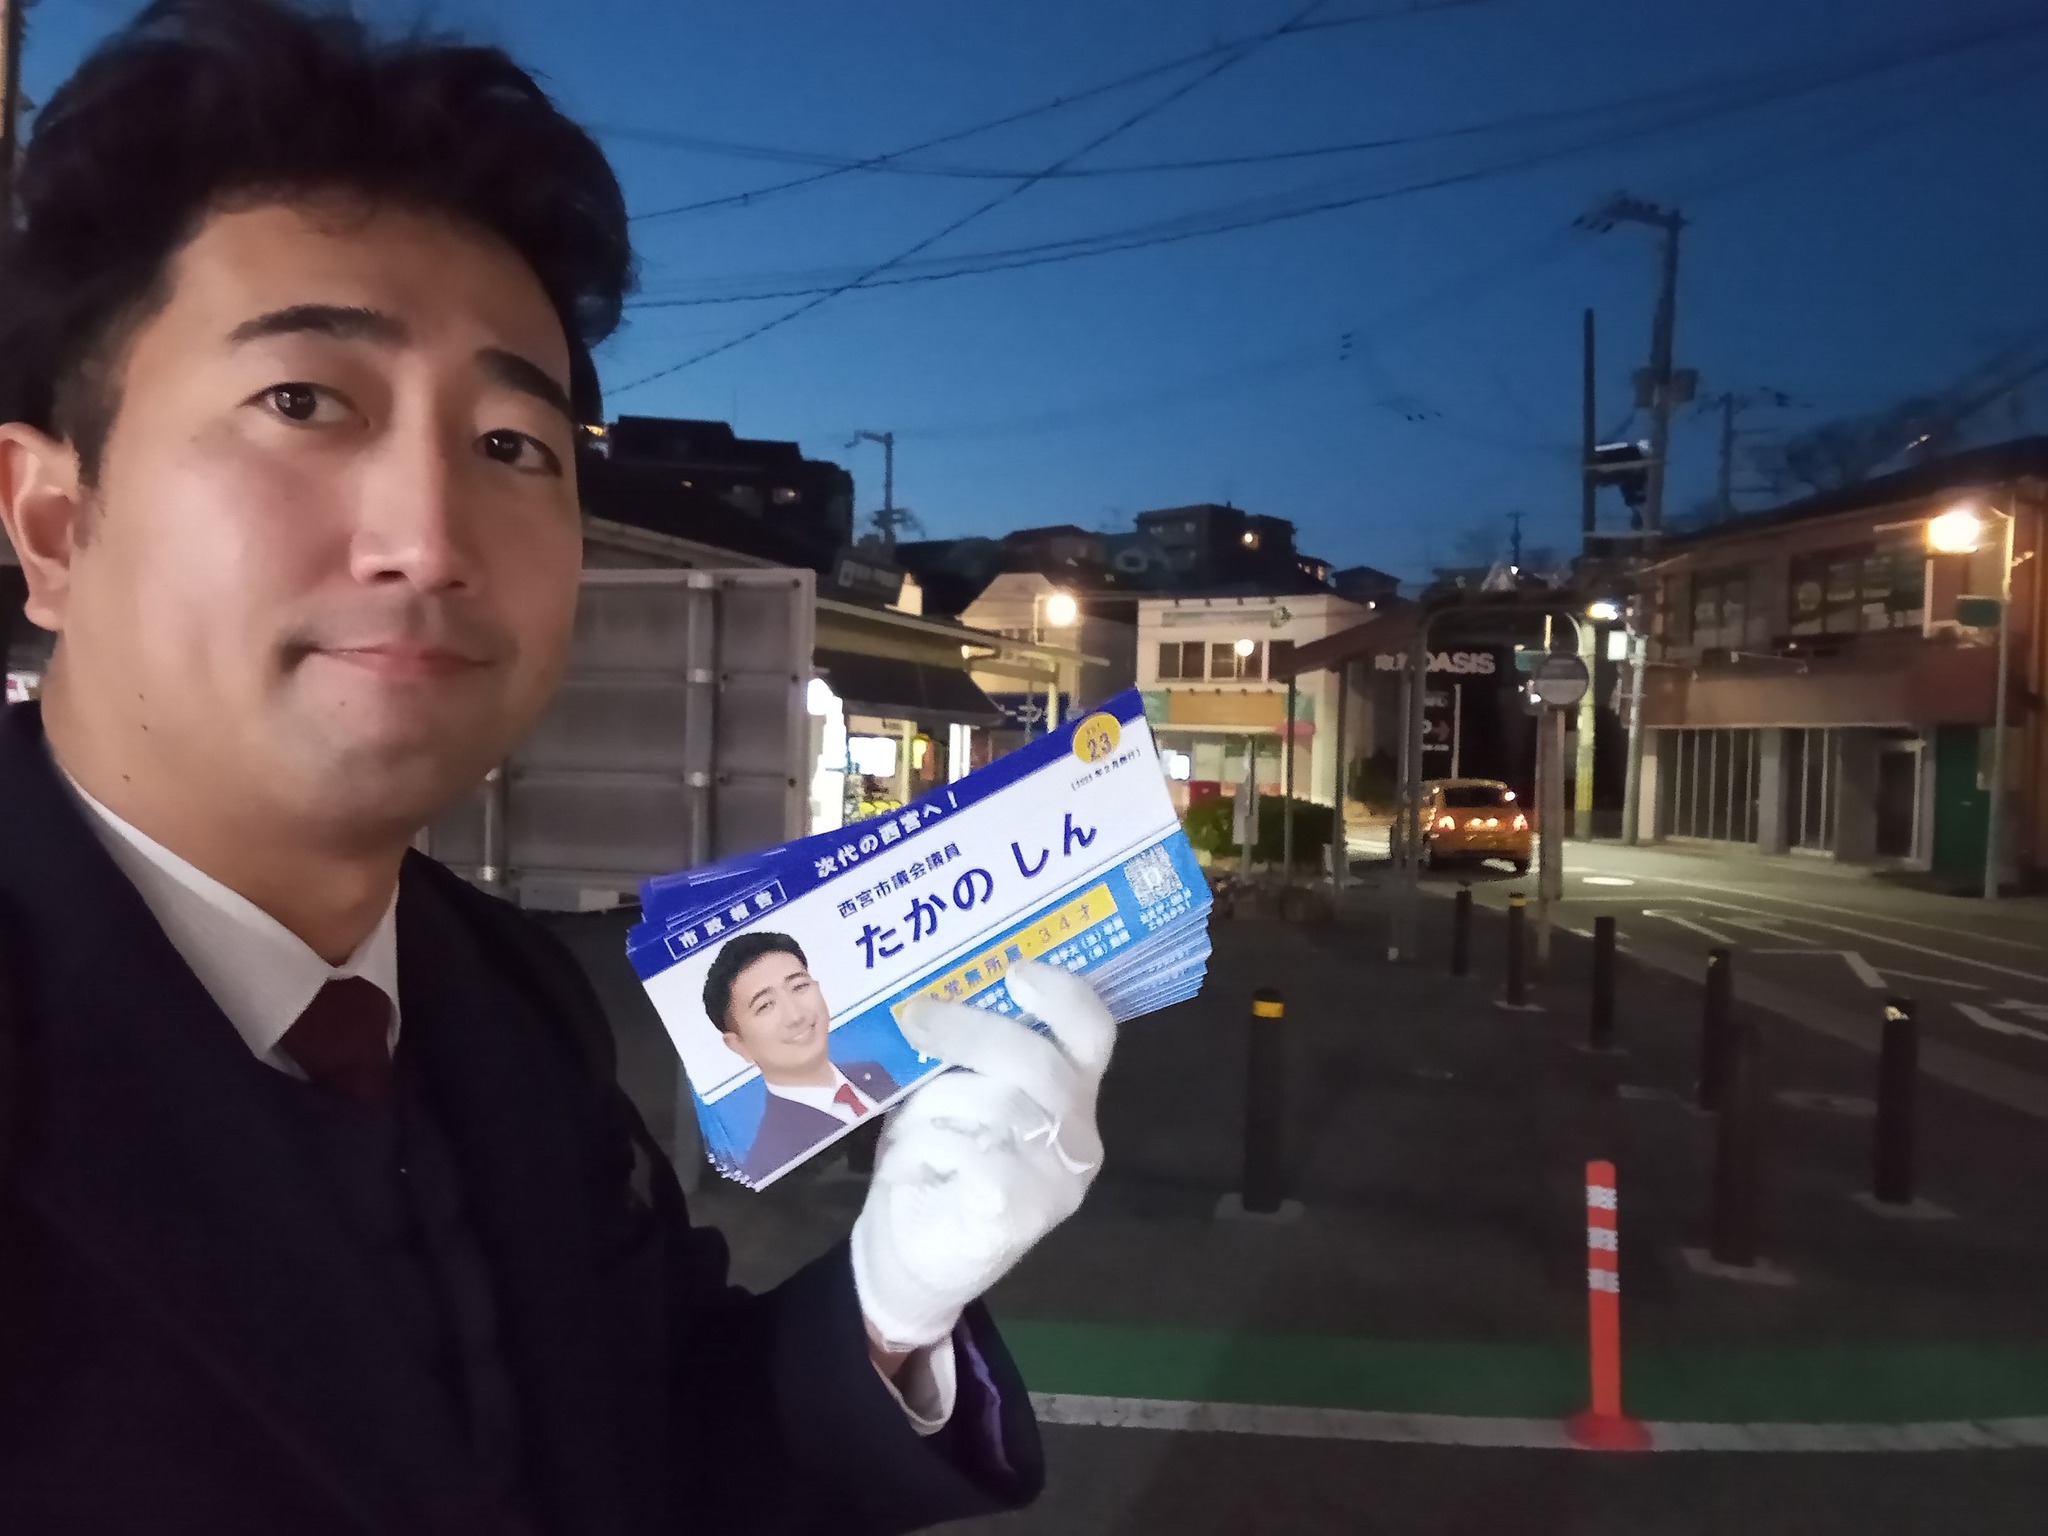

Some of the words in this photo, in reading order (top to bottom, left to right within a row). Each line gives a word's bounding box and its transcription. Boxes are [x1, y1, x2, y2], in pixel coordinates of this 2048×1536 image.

[1086, 731, 1112, 762] 23
[836, 843, 962, 919] 西宮市議会議員
[856, 867, 995, 969] たかの
[1015, 812, 1099, 878] しん
[678, 889, 774, 949] 市政報告
